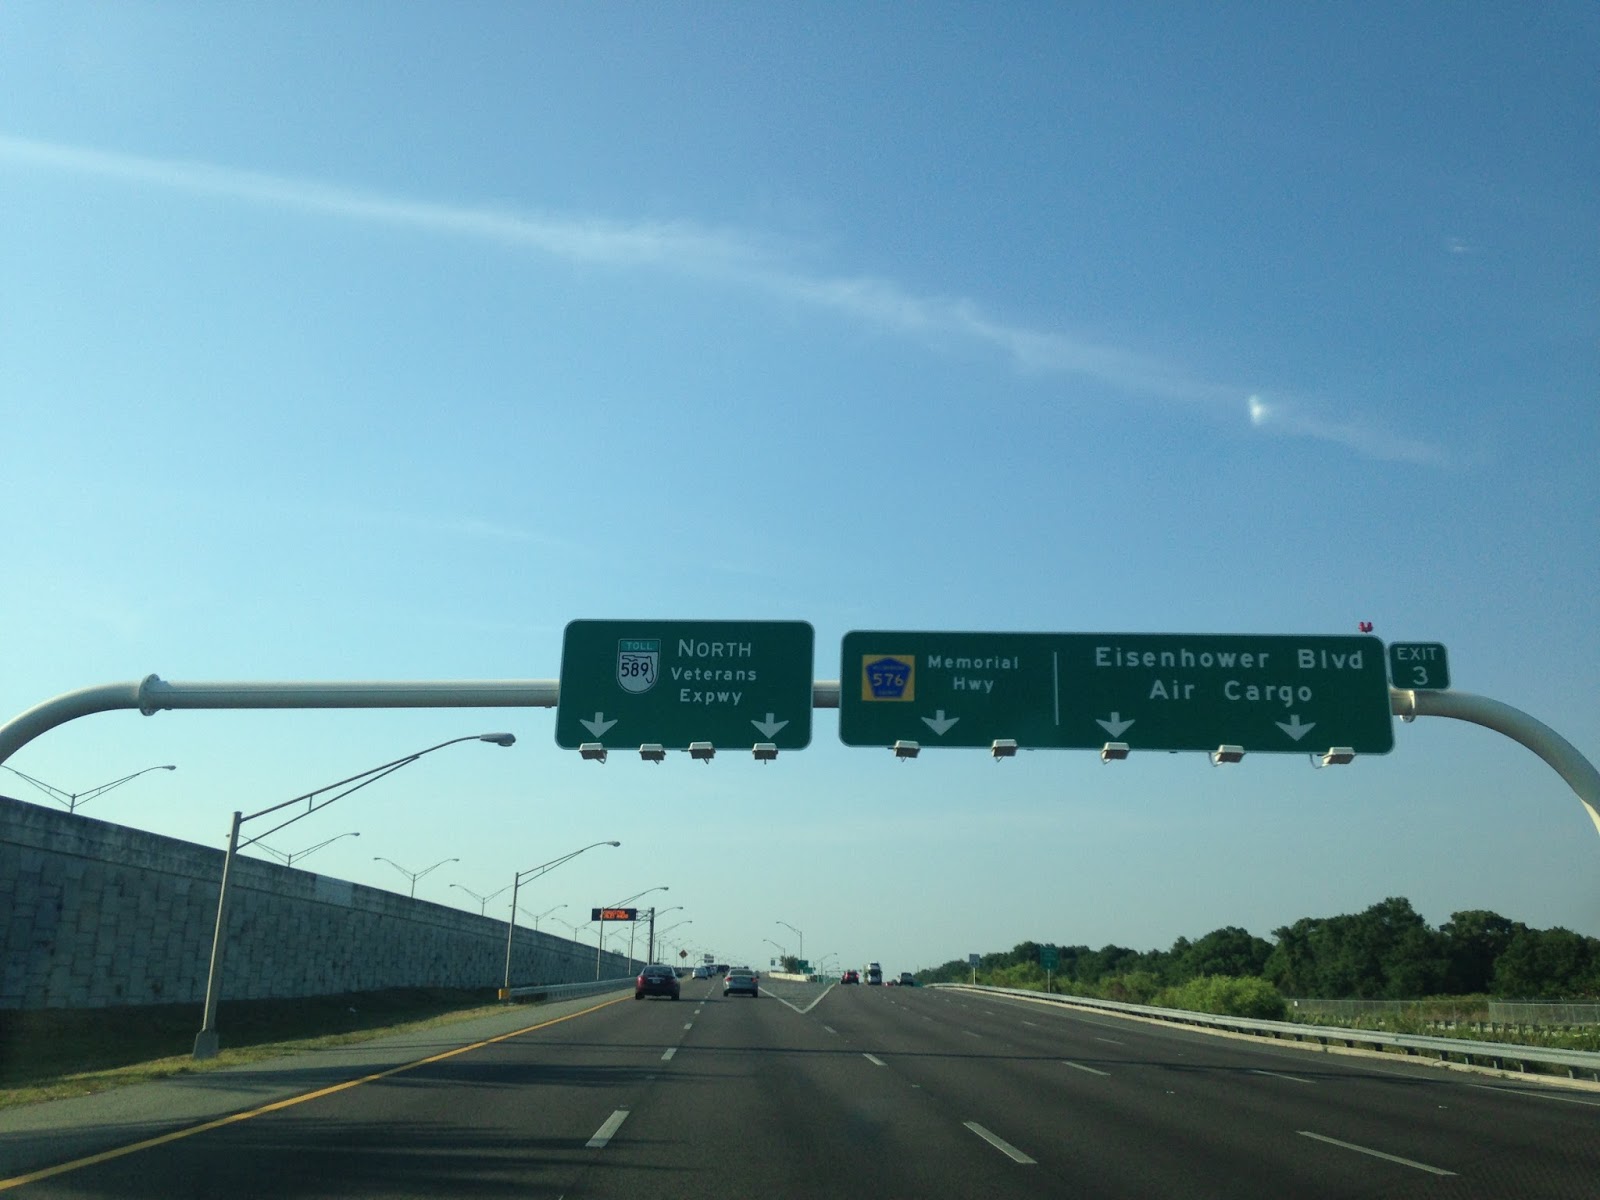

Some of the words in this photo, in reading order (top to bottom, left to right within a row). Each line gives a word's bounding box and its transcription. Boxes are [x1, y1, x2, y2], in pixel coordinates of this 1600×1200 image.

[626, 641, 653, 650] TOLL
[678, 639, 751, 657] NORTH
[1095, 647, 1269, 668] Eisenhower
[1298, 649, 1363, 669] Blvd
[1397, 647, 1437, 660] EXIT
[621, 662, 649, 677] 589
[927, 655, 1019, 669] Memorial
[671, 667, 757, 681] Veterans
[873, 673, 905, 687] 576
[1413, 666, 1429, 685] 3
[953, 677, 994, 693] Hwy
[680, 689, 743, 705] Expwy
[1150, 680, 1195, 700] Air
[1224, 681, 1312, 706] Cargo
